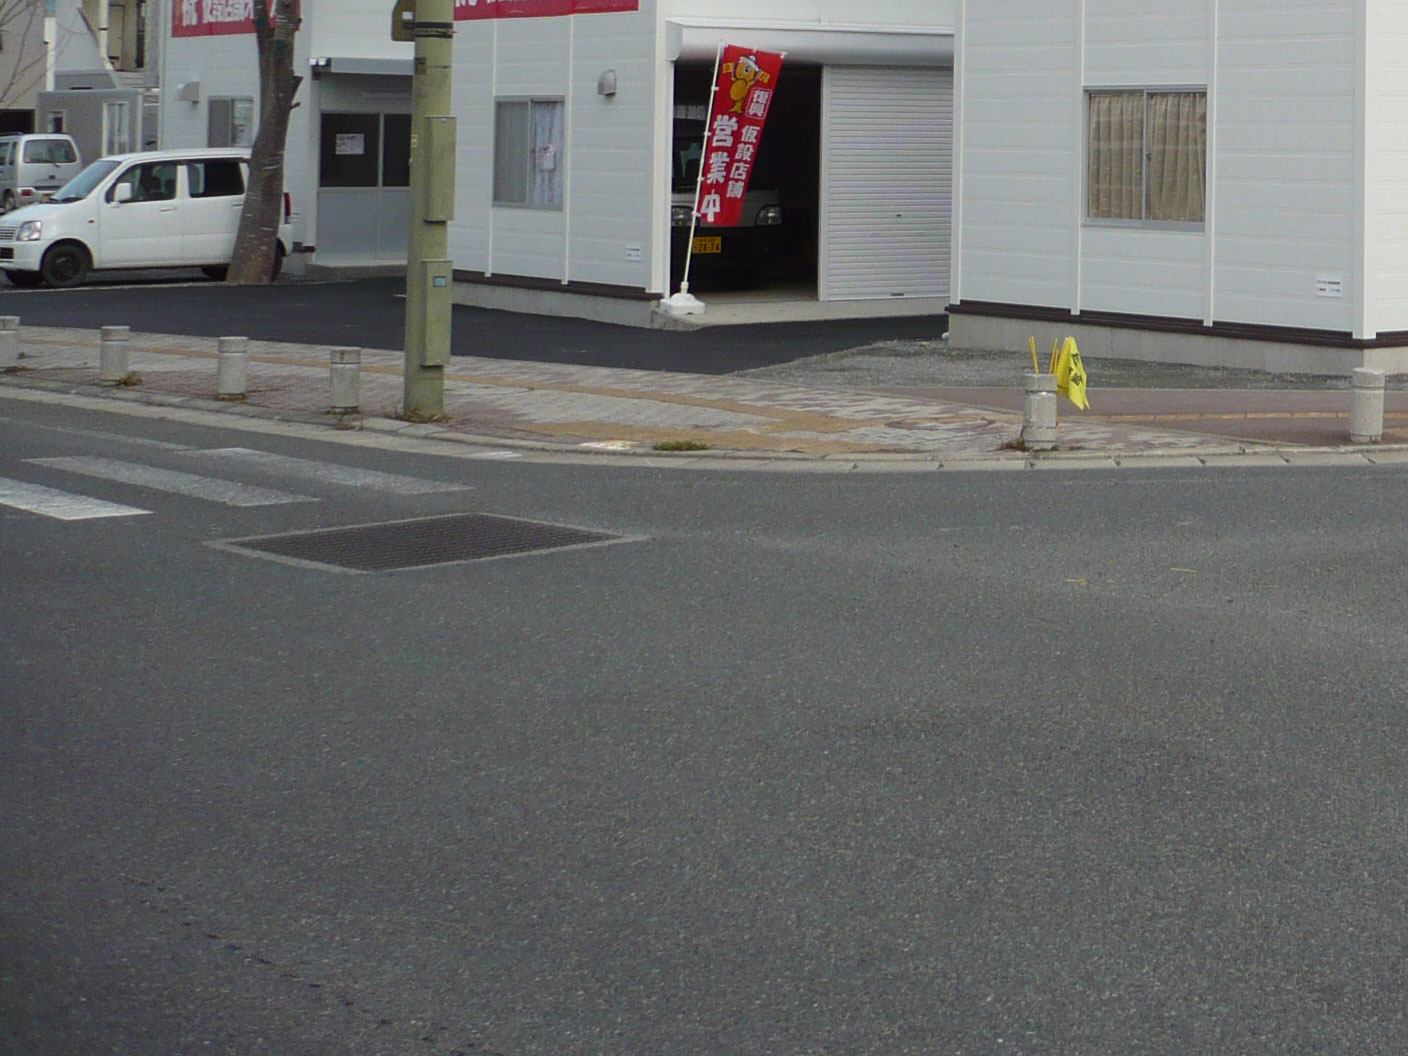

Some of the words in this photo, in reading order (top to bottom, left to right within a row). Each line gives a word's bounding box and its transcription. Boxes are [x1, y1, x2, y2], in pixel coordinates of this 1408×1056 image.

[700, 114, 738, 222] 営業中
[726, 125, 761, 199] 仮設店舗
